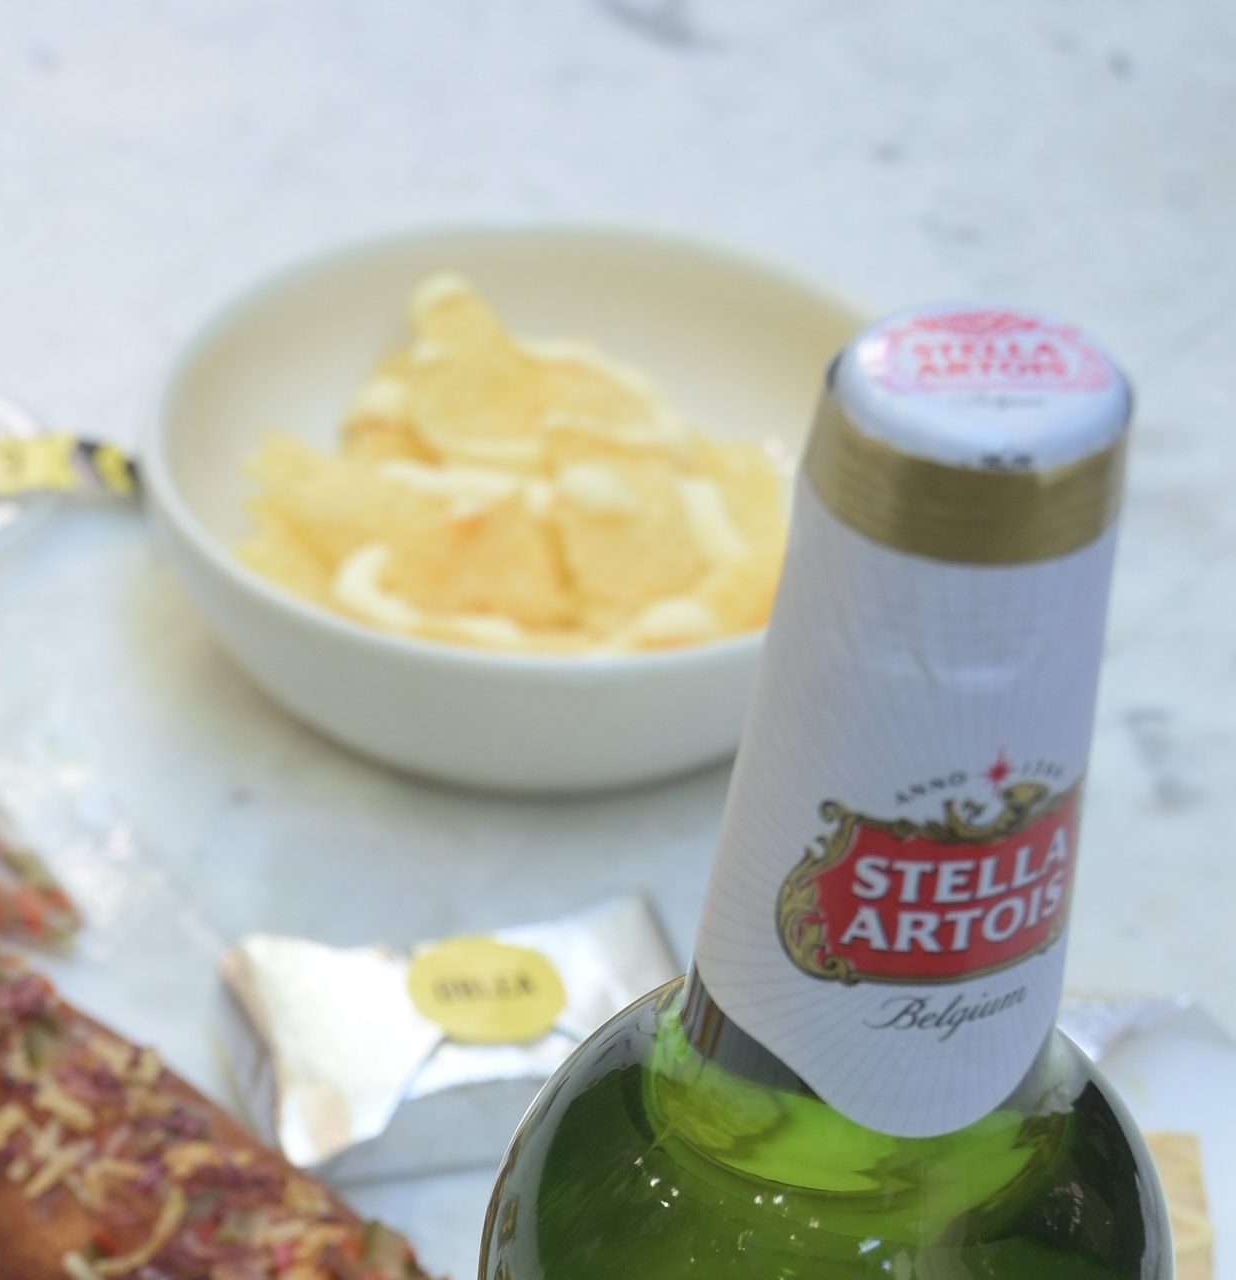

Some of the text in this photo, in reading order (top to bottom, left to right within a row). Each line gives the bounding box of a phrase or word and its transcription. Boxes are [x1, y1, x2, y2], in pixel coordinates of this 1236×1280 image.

[894, 768, 967, 805] ANNO
[851, 826, 1069, 904] STELLA
[840, 871, 1064, 953] ARTOIS
[861, 985, 1028, 1043] Belgium
